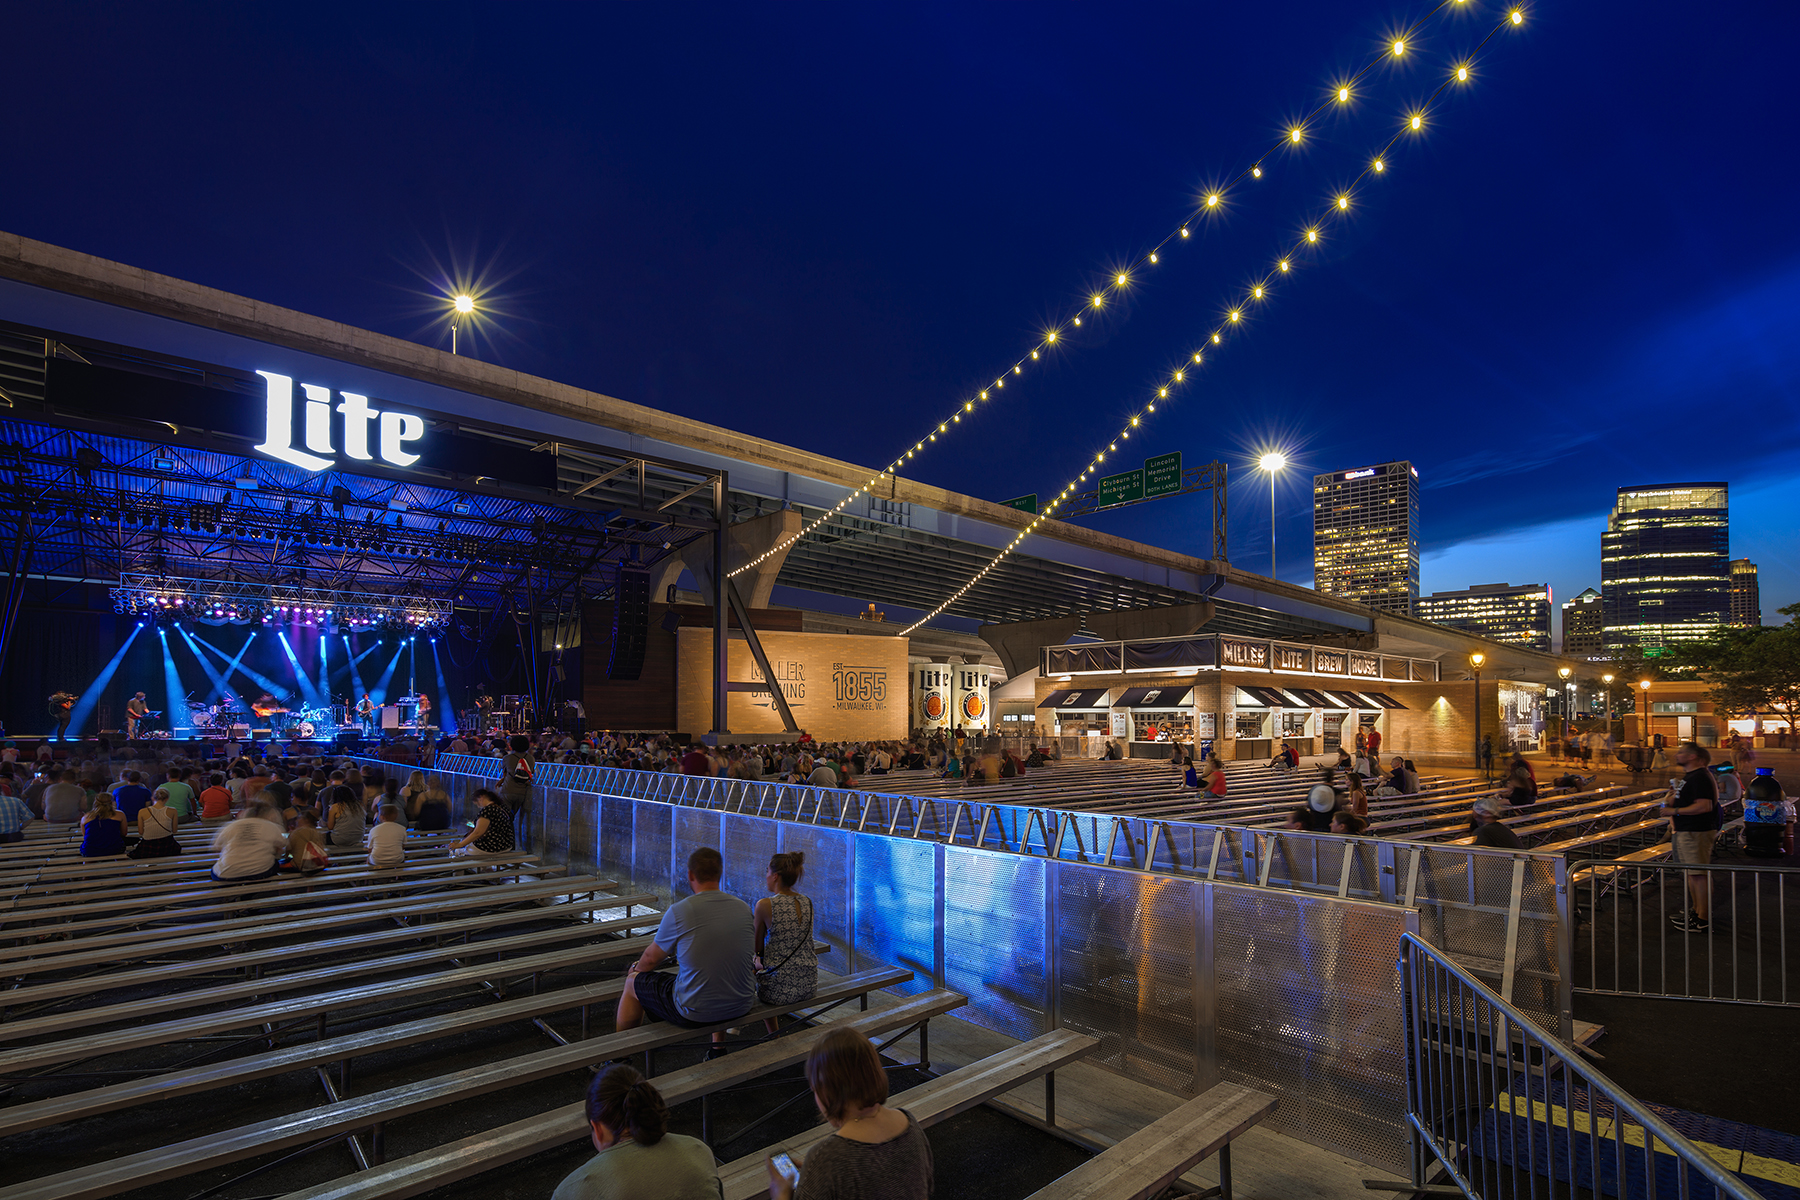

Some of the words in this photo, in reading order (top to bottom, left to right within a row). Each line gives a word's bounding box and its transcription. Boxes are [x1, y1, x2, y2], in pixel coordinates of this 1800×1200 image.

[253, 369, 424, 472] Lite
[1150, 457, 1175, 468] Lincoln
[1147, 464, 1178, 476] Memorial
[1102, 476, 1131, 487] Clybourn
[1132, 473, 1140, 481] St
[1153, 474, 1171, 483] Drive
[1102, 484, 1131, 495] Michigan
[1161, 482, 1178, 490] LANES
[1223, 643, 1265, 664] MILLER
[1281, 650, 1303, 669] LITE
[1317, 654, 1343, 672] BREW
[1351, 656, 1377, 675] HOUSE
[832, 670, 887, 702] 1855
[919, 670, 949, 691] Lite
[959, 670, 988, 691] Lite
